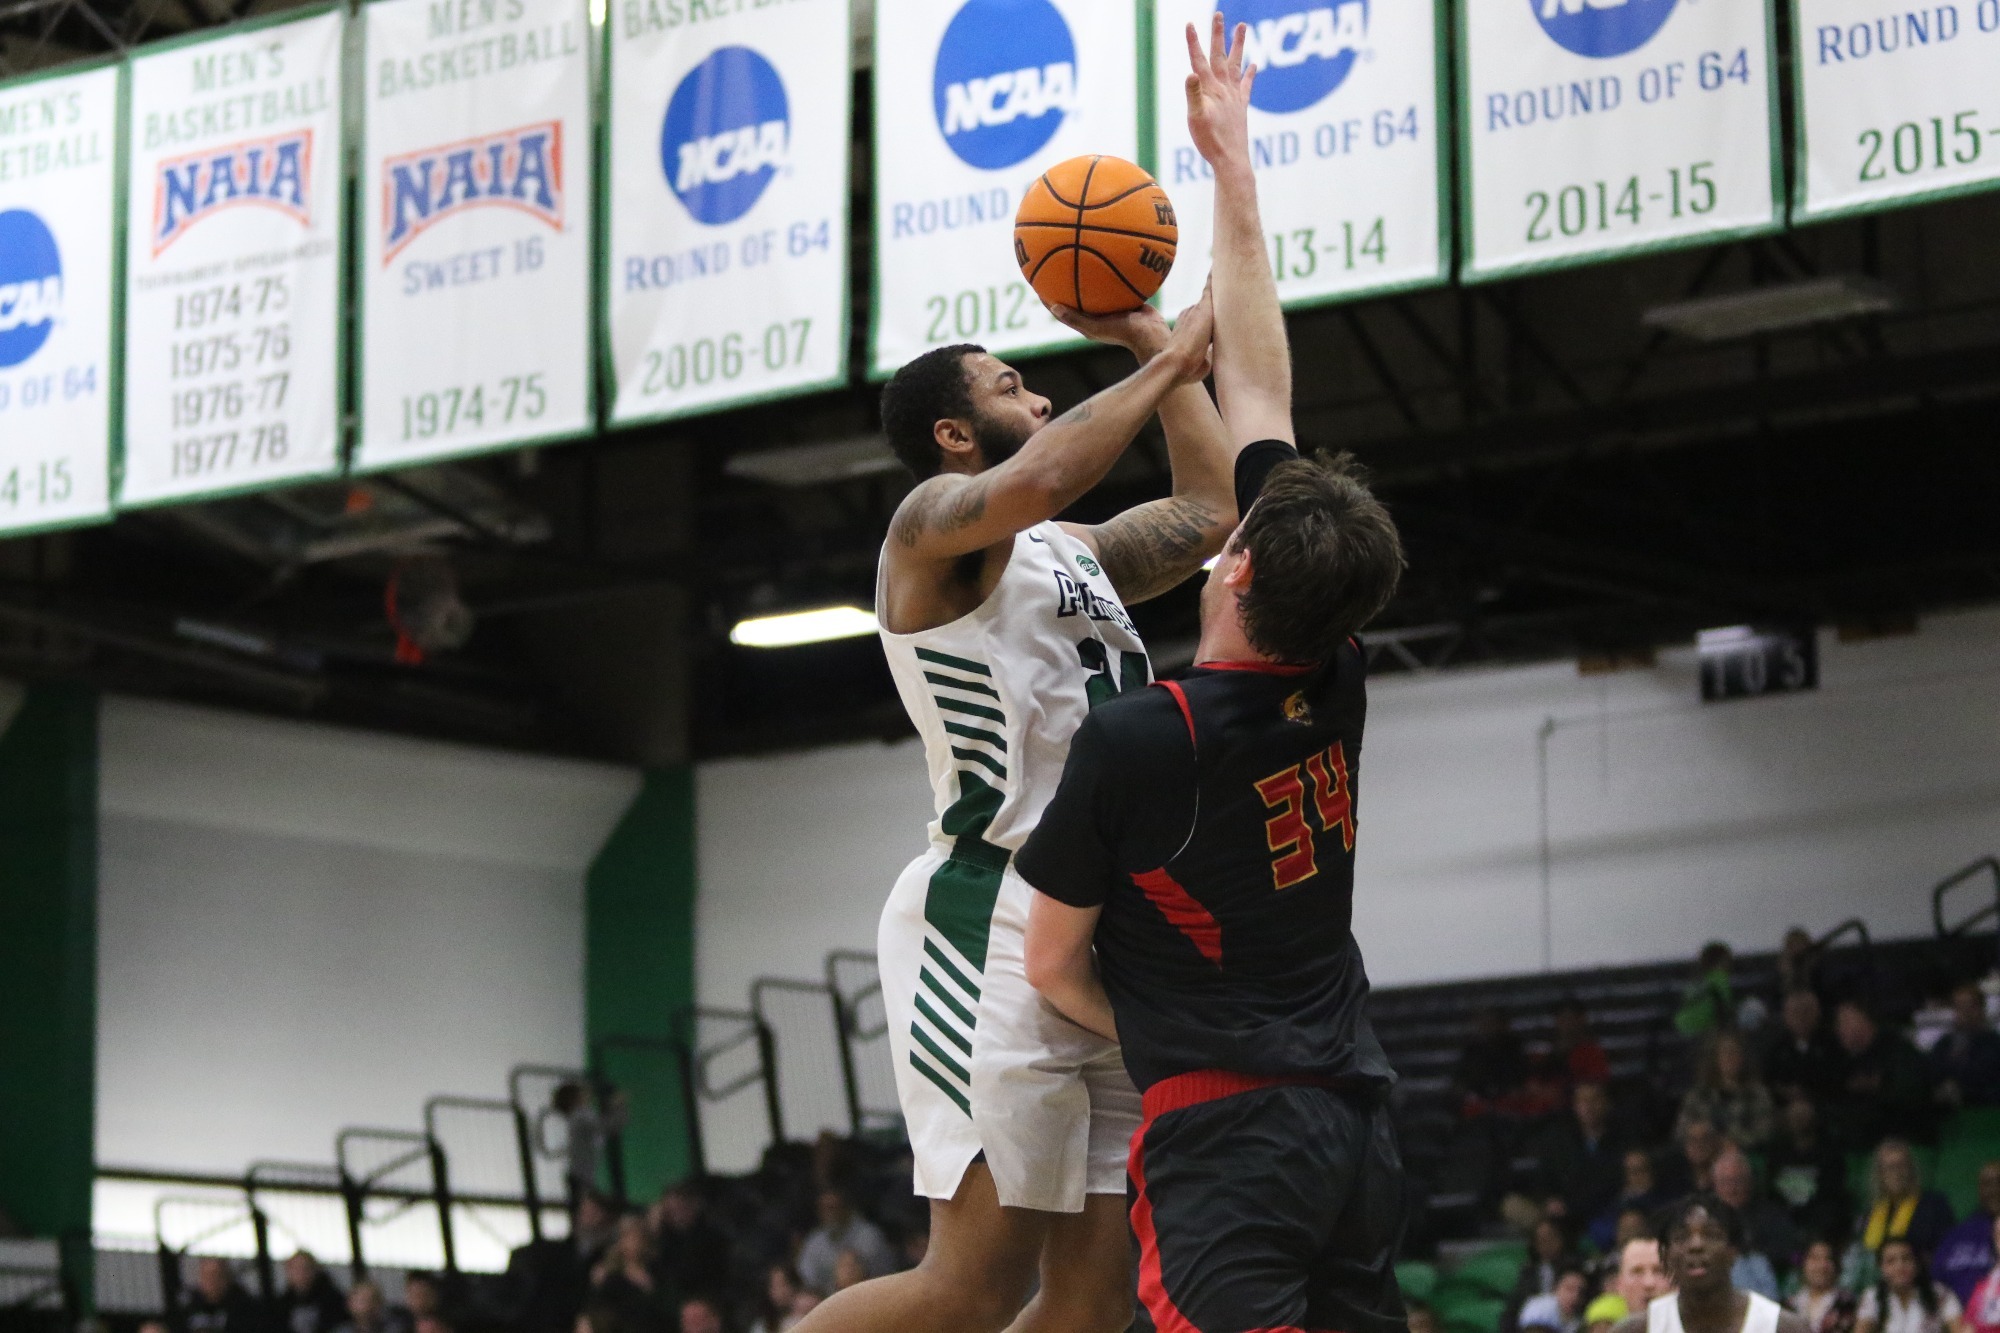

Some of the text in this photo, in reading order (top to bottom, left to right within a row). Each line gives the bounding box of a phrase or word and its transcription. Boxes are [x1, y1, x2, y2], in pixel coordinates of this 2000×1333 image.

[193, 43, 284, 92] MEN'S
[379, 21, 577, 98] BASKETBALL
[1233, 2, 1364, 71] NCAA
[1817, 5, 1959, 65] ROUND
[146, 77, 330, 149] BASKETBALL
[943, 61, 1074, 135] NCAA
[1487, 47, 1749, 132] ROUND OF 64
[676, 118, 787, 193] NCAA
[1315, 119, 1362, 158] OF
[1373, 104, 1418, 148] 64
[160, 138, 305, 238] NAIA
[389, 132, 554, 243] NAIA
[892, 187, 1009, 238] ROUND
[1525, 160, 1717, 243] 2014-15
[404, 234, 544, 296] SWEET 16
[741, 231, 776, 267] OF
[788, 218, 829, 258] 64
[1273, 216, 1387, 281] 13-14
[176, 274, 288, 330] 1974-75
[926, 281, 1042, 343] 2012-
[171, 322, 290, 379] 1975-76
[642, 317, 812, 396] 2006-07
[22, 379, 51, 407] OF
[63, 364, 96, 399] 64
[172, 371, 290, 429] 1976-77
[404, 371, 546, 440] 1974-75
[171, 422, 288, 478] 1977-78
[1253, 739, 1355, 891] 34
